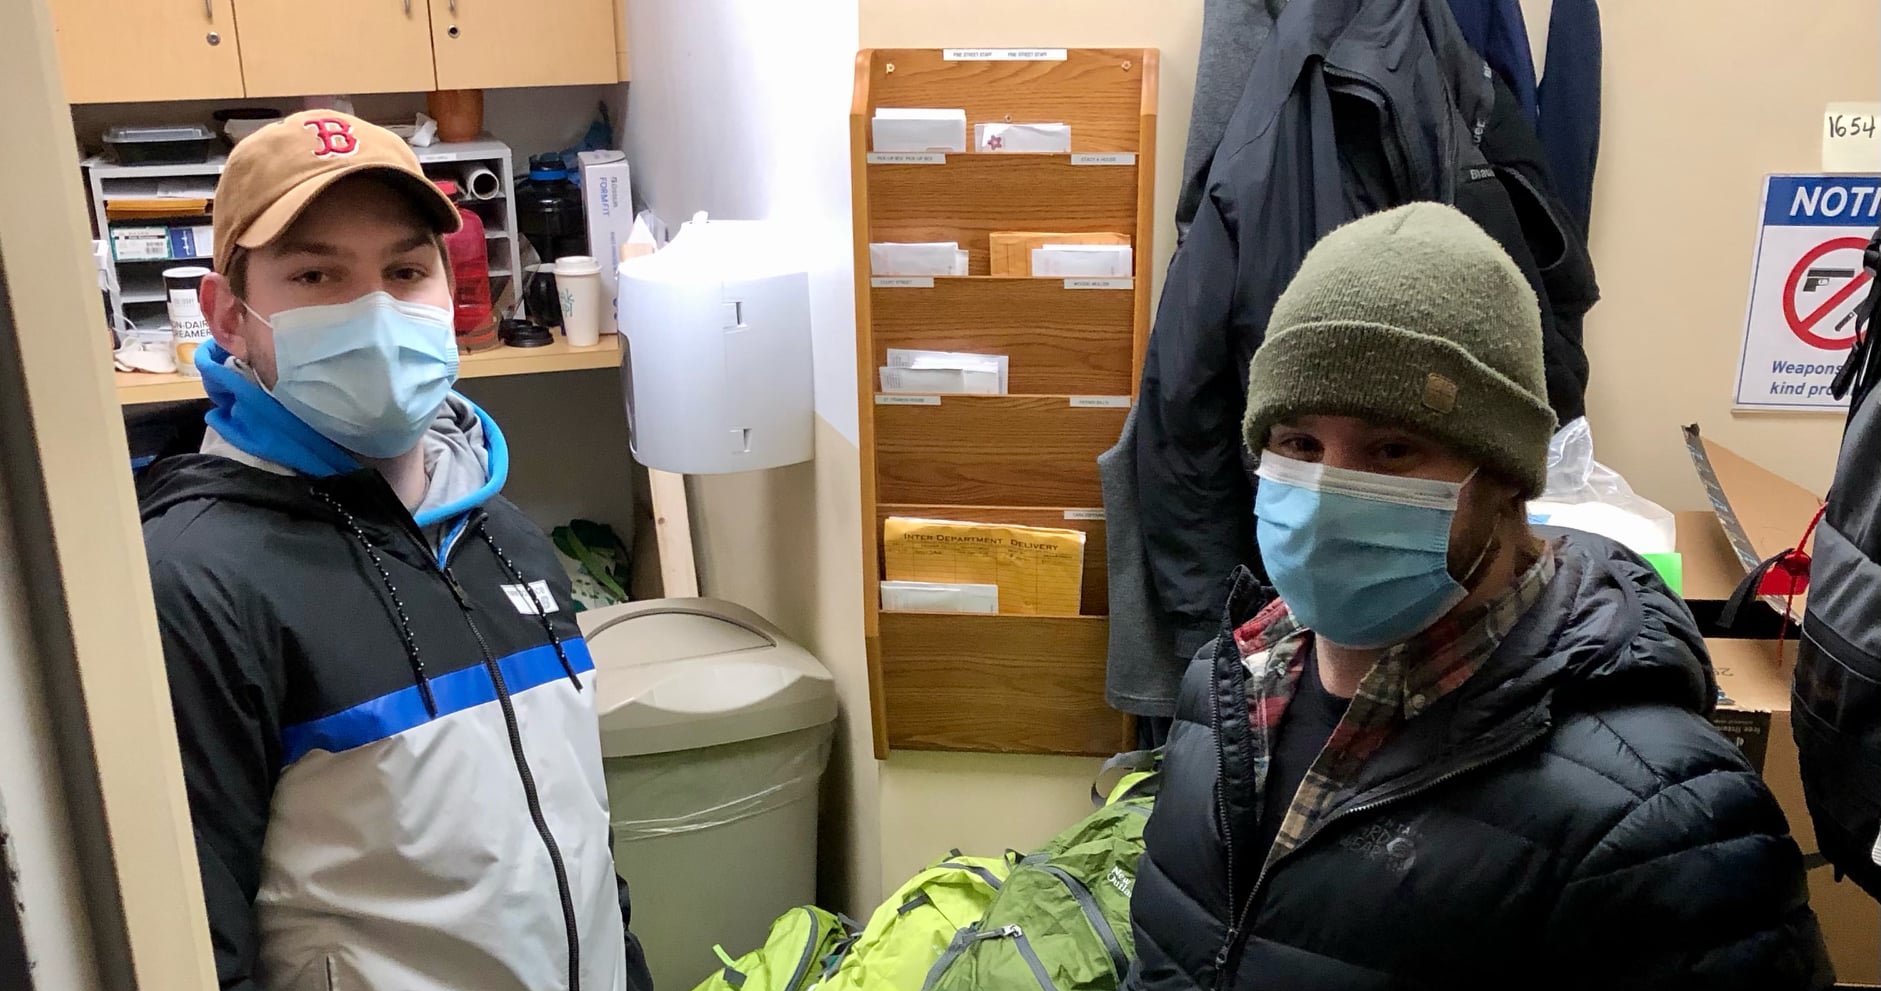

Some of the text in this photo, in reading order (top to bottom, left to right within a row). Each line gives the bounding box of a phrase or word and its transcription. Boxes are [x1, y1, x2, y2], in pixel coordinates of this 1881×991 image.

[1828, 114, 1876, 138] 1654
[304, 118, 359, 159] B
[1771, 360, 1844, 377] Weapons
[1769, 382, 1806, 395] kind
[1010, 539, 1059, 550] DELIVERY
[1111, 865, 1131, 884] New
